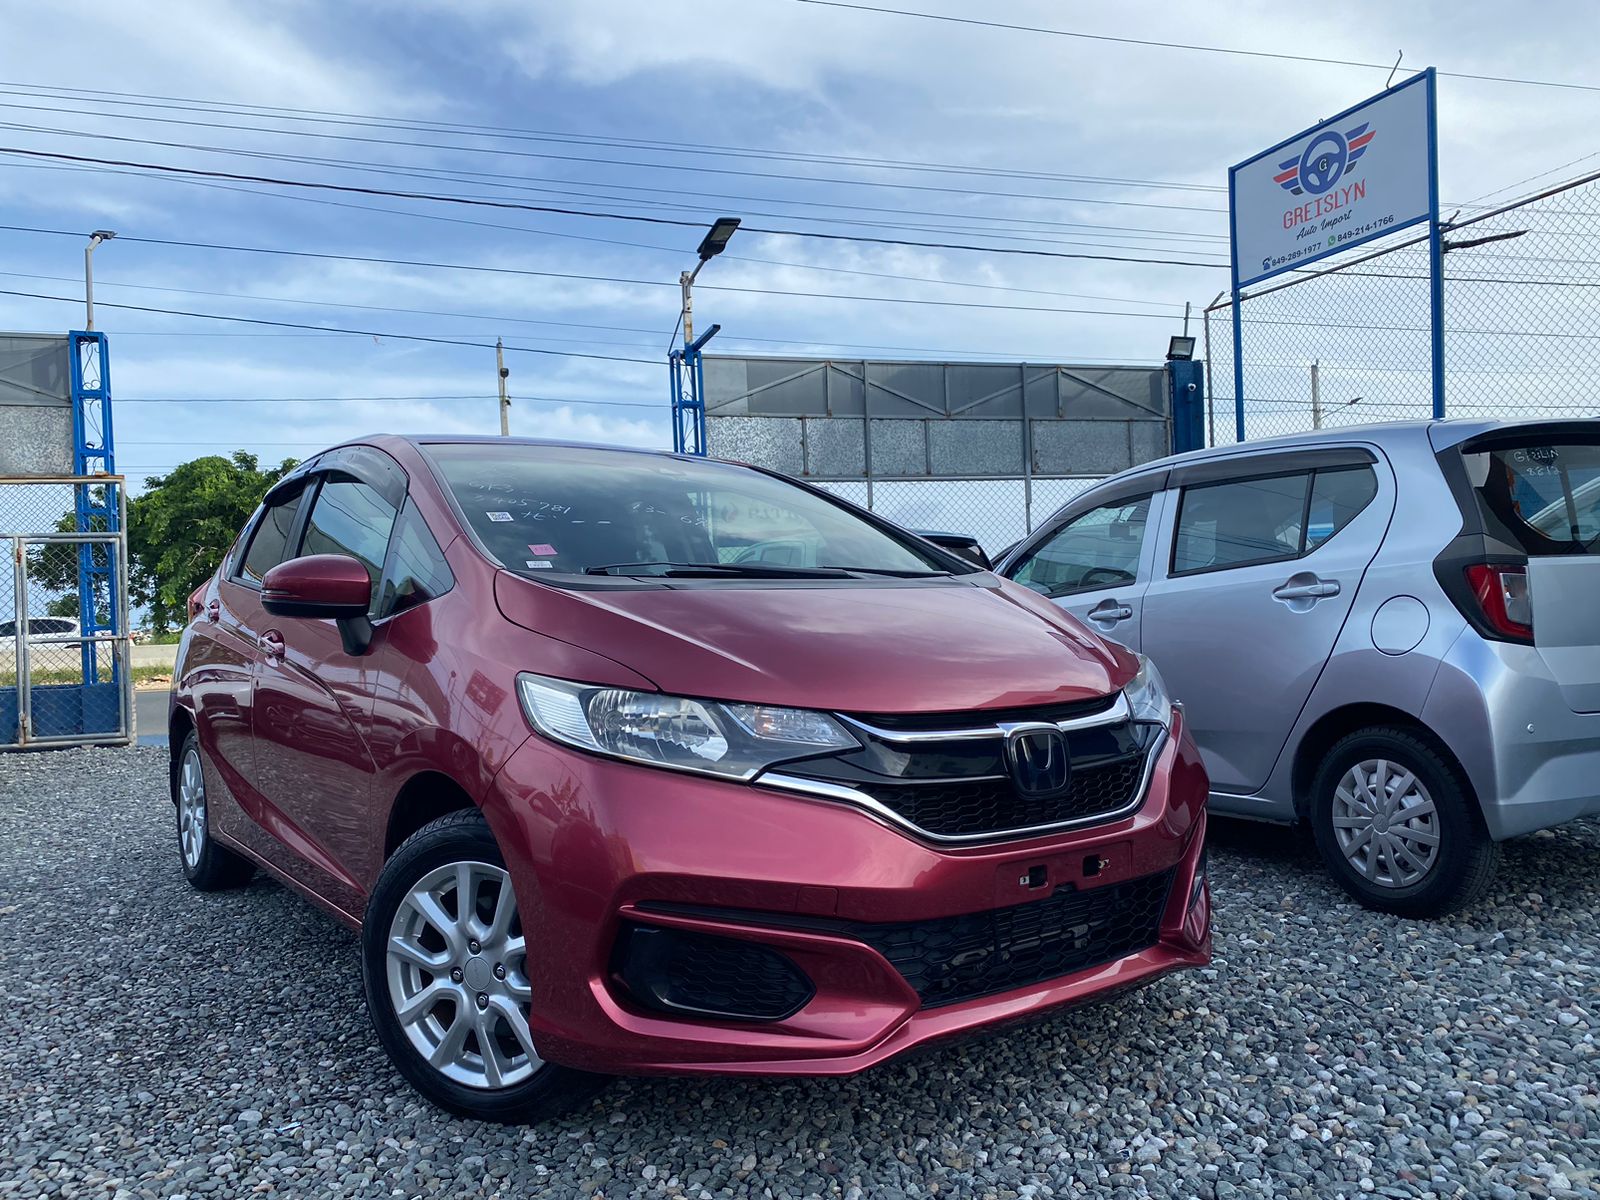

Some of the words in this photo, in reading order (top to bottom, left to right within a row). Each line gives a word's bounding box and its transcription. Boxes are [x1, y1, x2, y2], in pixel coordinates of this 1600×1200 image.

[1283, 178, 1366, 230] GREISLYN
[1296, 224, 1318, 240] Auto
[1321, 209, 1353, 230] Import
[1271, 242, 1322, 267] 849-289-1977
[1337, 214, 1395, 242] 849-214-1766
